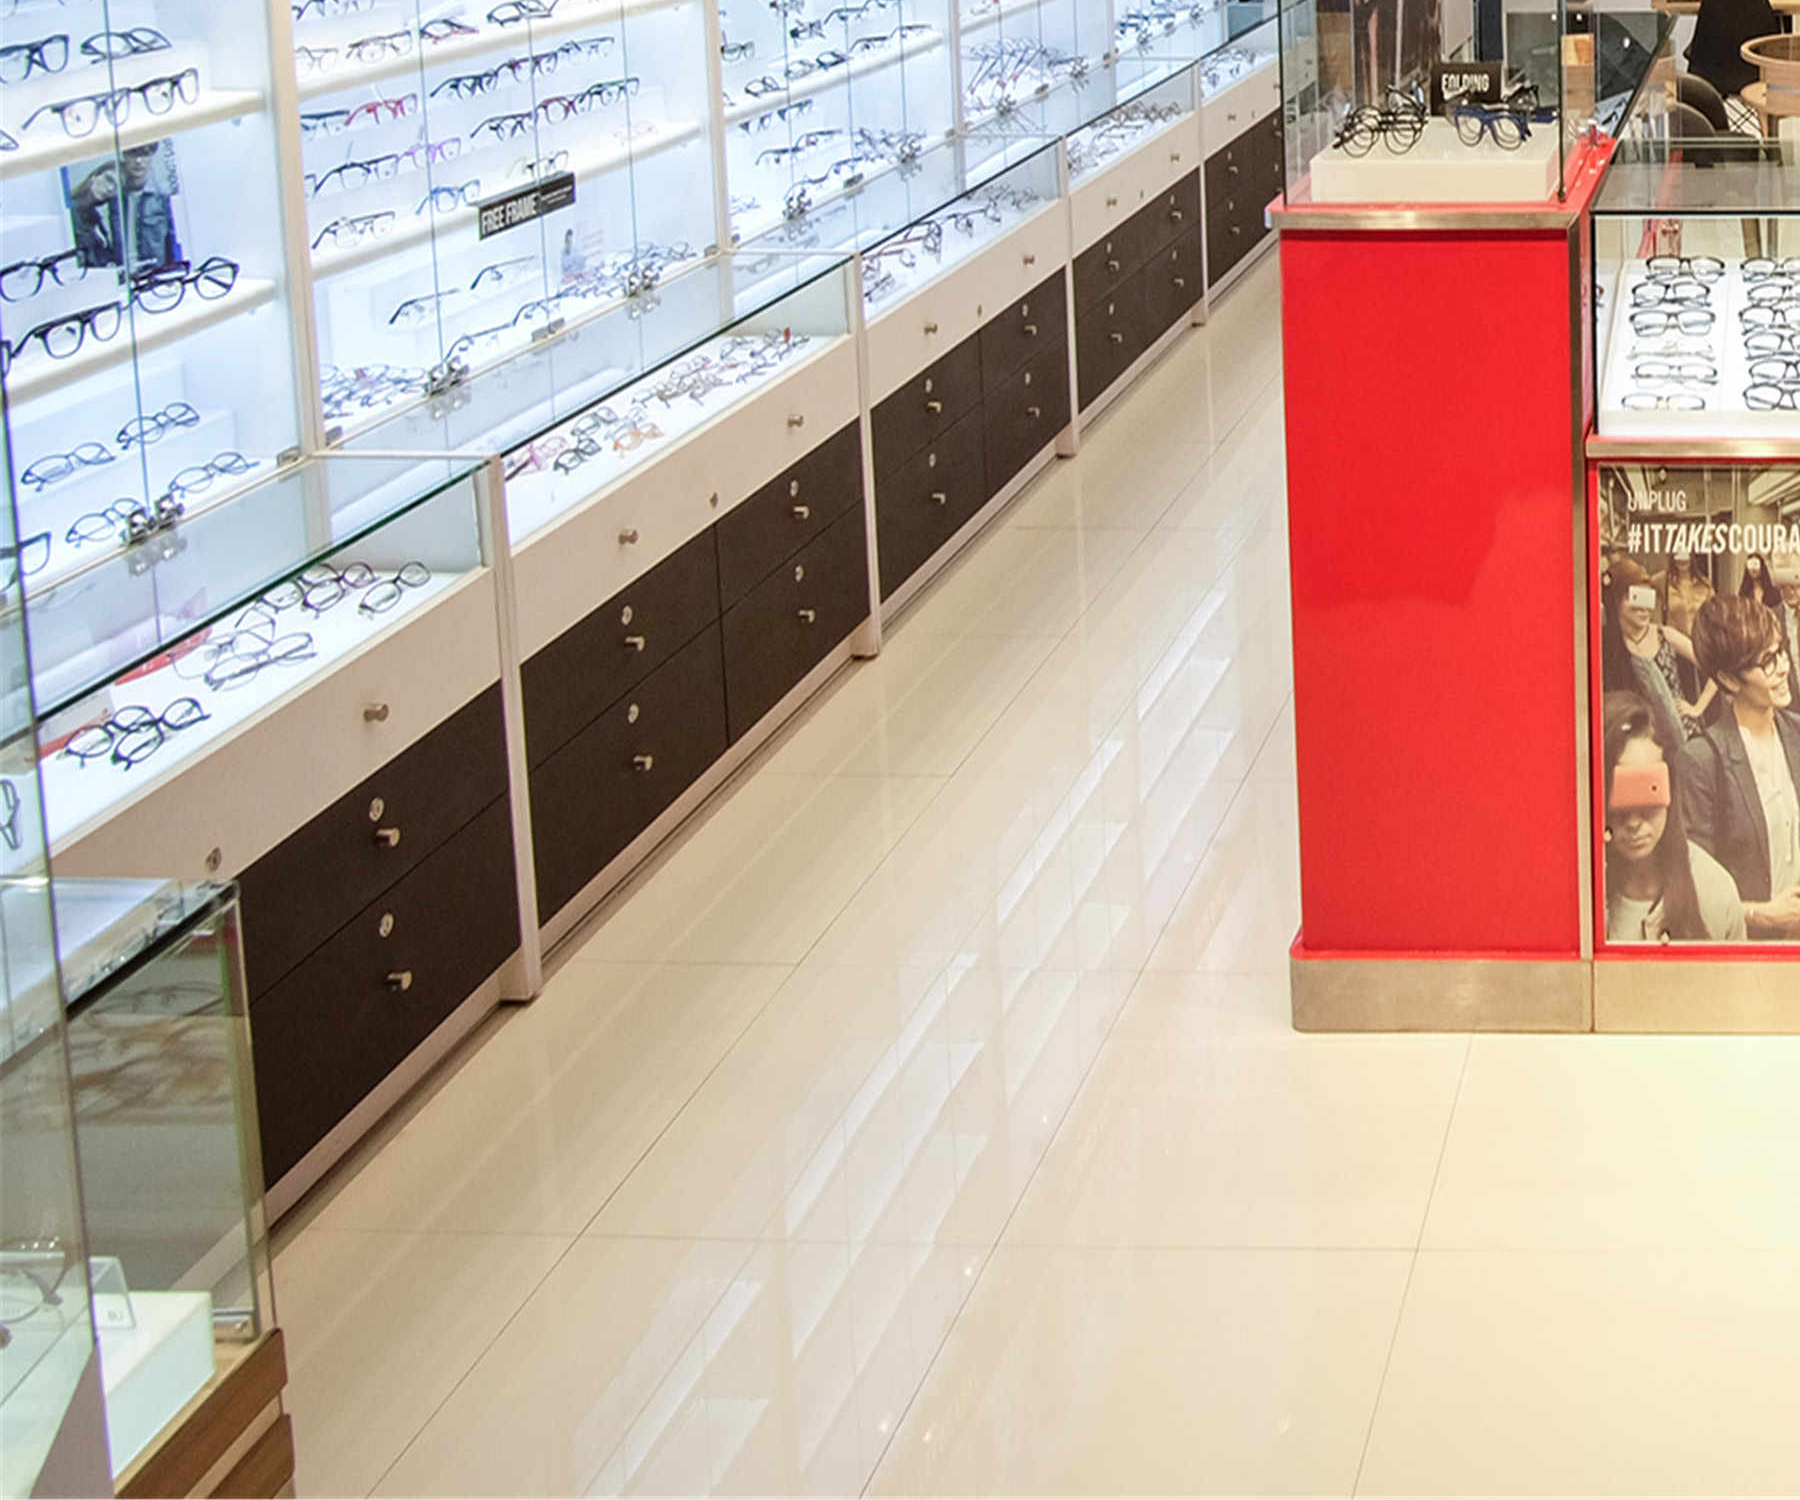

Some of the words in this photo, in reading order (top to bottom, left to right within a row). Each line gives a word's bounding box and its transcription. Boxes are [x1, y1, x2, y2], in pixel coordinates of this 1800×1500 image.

[1442, 73, 1490, 92] FOLDING
[481, 205, 505, 235] FREE
[505, 193, 538, 226] FRAME
[1627, 490, 1687, 512] UNPLUG
